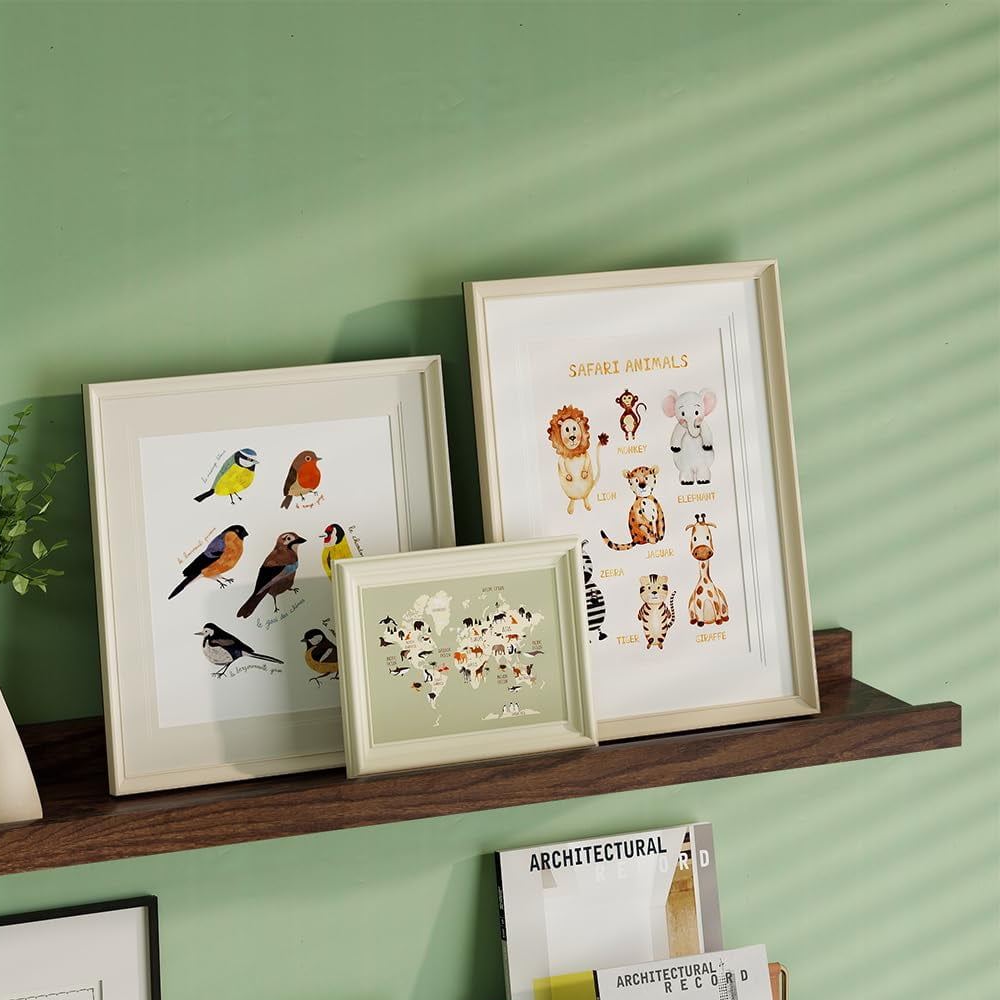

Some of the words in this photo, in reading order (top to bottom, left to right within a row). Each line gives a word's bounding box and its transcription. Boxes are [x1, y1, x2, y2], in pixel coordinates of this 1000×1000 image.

[568, 360, 619, 378] SAFARI
[625, 354, 688, 373] ANIMALS
[617, 444, 648, 456] MONKEY
[596, 491, 617, 502] LION
[677, 492, 716, 504] ELEPHANT
[646, 548, 675, 559] JAGUAR
[599, 567, 625, 579] ZEBRA
[616, 635, 640, 645] TIGER
[695, 631, 727, 643] GIRAFFE
[529, 836, 667, 872] ARCHITECTURAL
[616, 961, 717, 988] ARCHITECTURAL
[664, 969, 749, 993] RECORD
